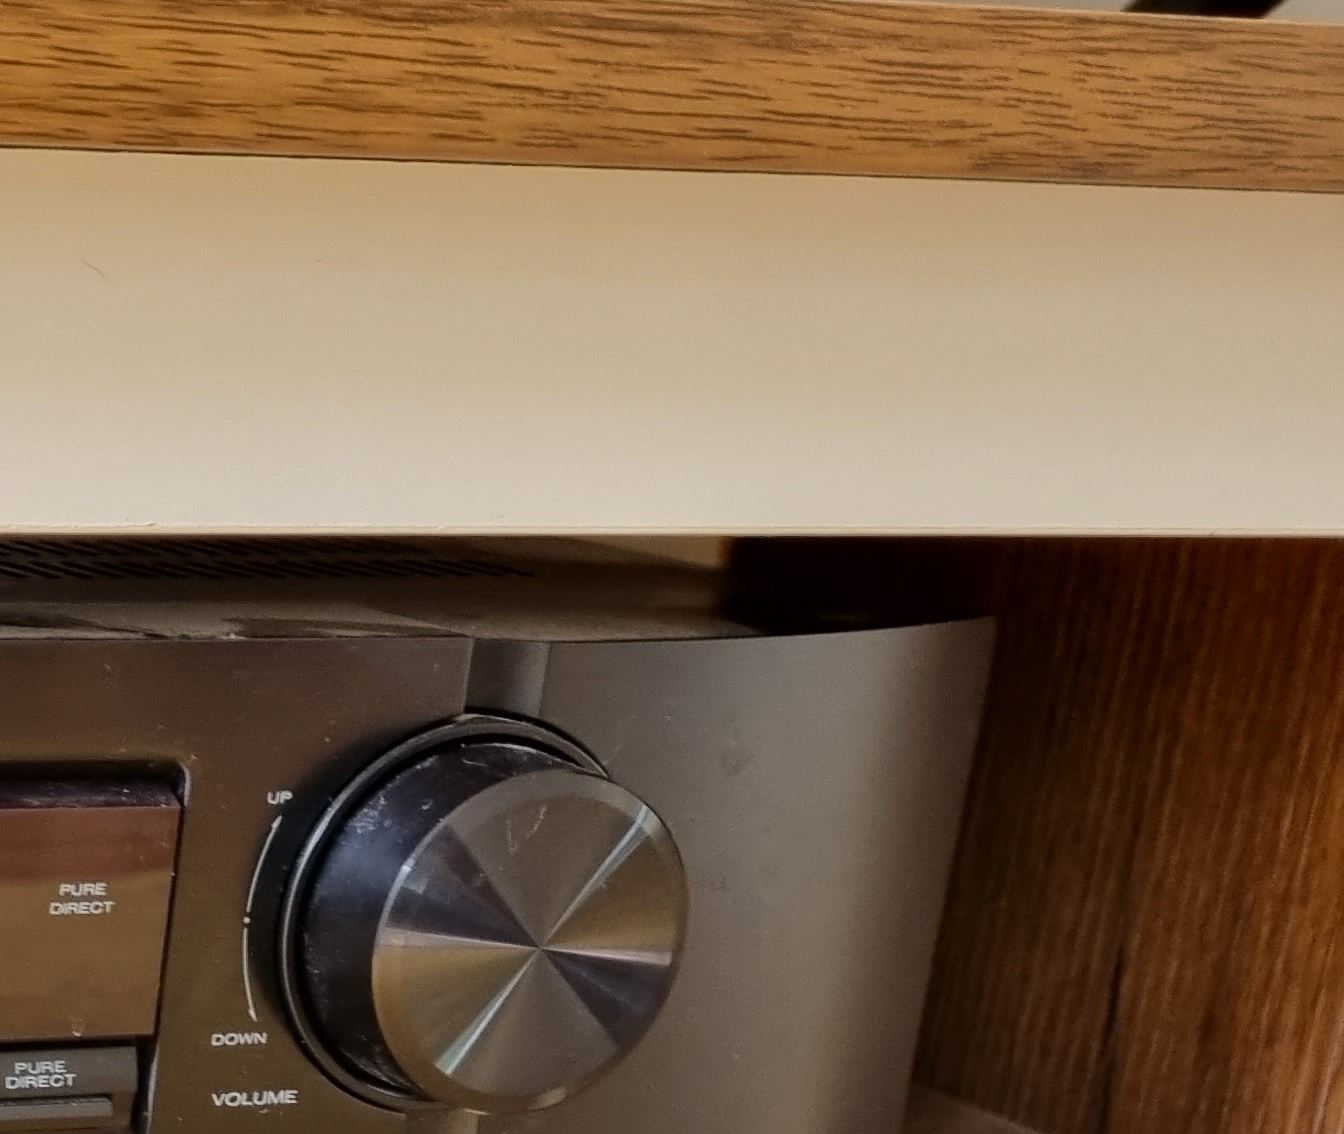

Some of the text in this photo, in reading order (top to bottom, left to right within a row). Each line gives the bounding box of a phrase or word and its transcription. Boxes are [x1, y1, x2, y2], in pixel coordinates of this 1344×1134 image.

[267, 790, 292, 805] UP
[59, 882, 107, 897] PURE
[49, 901, 115, 916] DIRECT
[212, 1031, 267, 1047] DOWN
[15, 1060, 66, 1075] PURE
[5, 1073, 76, 1089] DIRECT
[212, 1089, 298, 1107] VOLUME
